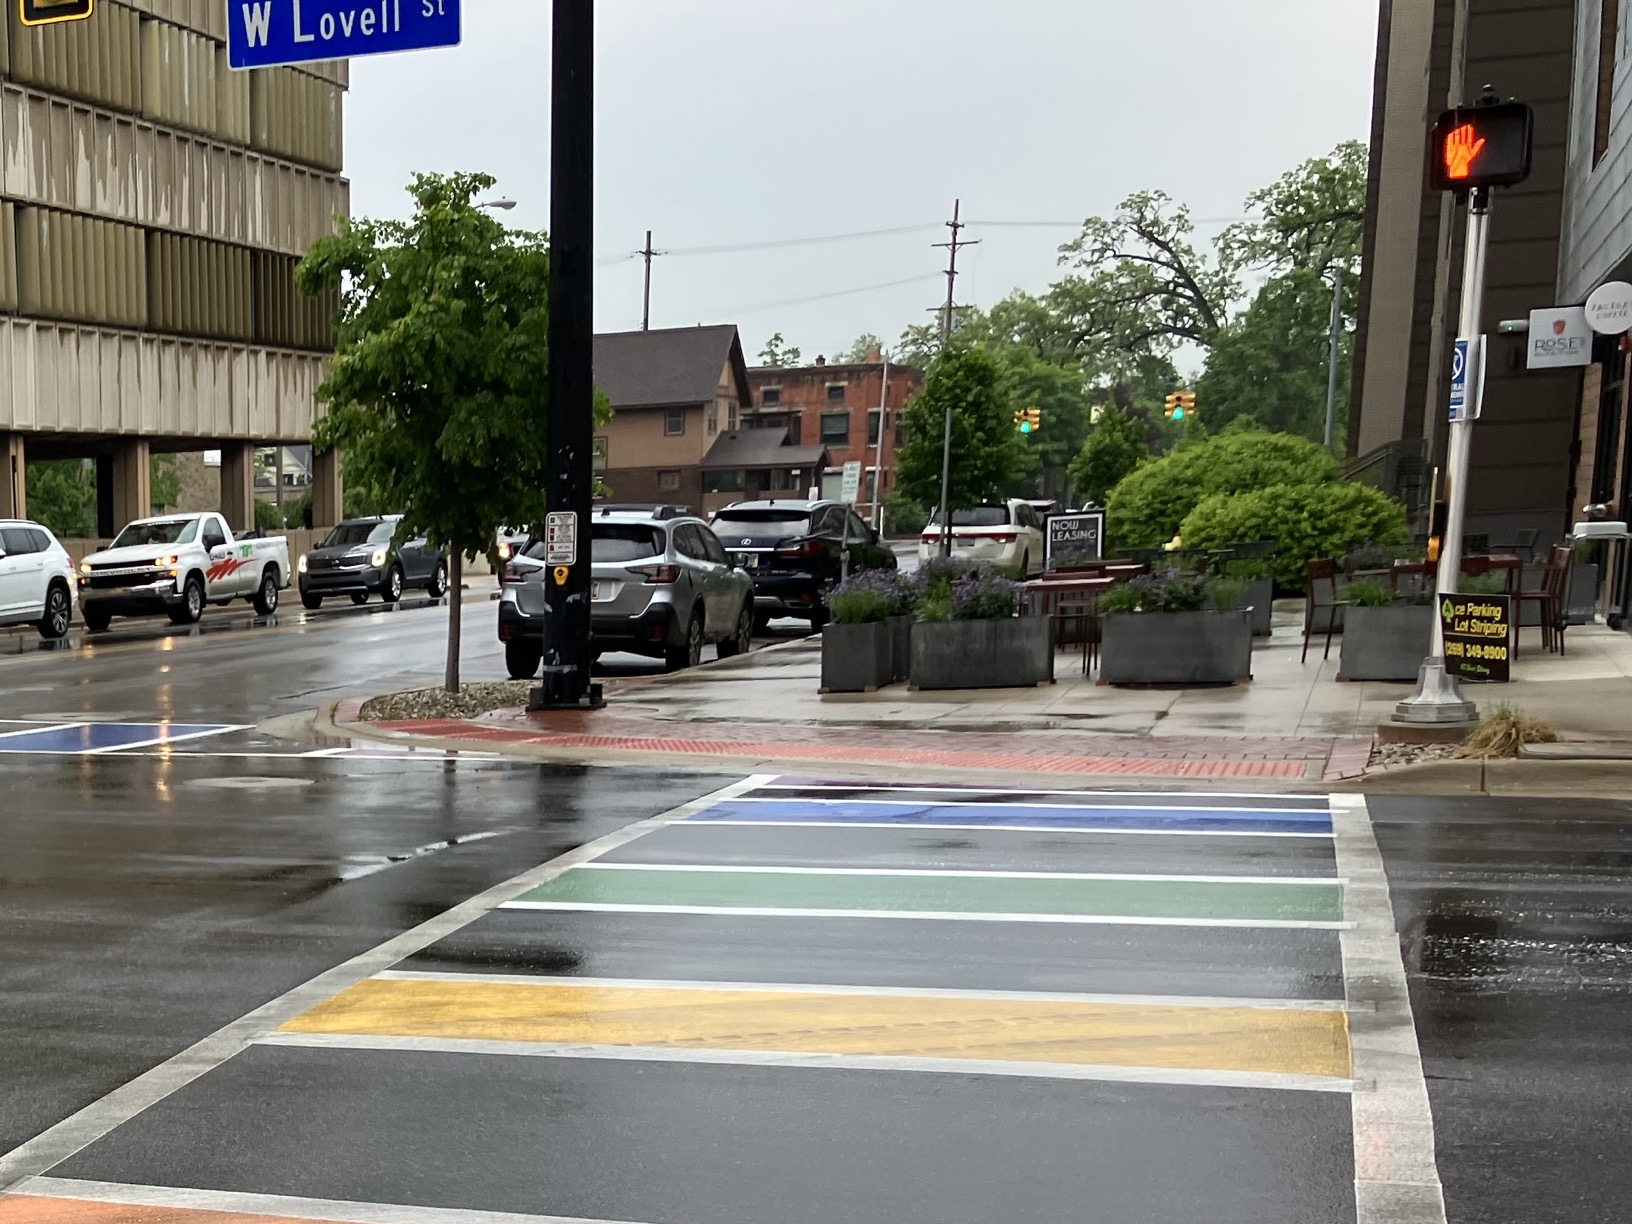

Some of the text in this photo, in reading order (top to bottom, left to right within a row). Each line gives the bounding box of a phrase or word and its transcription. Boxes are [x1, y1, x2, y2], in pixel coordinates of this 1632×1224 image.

[241, 1, 272, 48] W
[292, 0, 400, 43] Lovell
[1051, 520, 1080, 531] NOW
[1051, 529, 1097, 542] LEASING
[1467, 602, 1503, 621] Parking
[1454, 618, 1508, 638] Lot Striping
